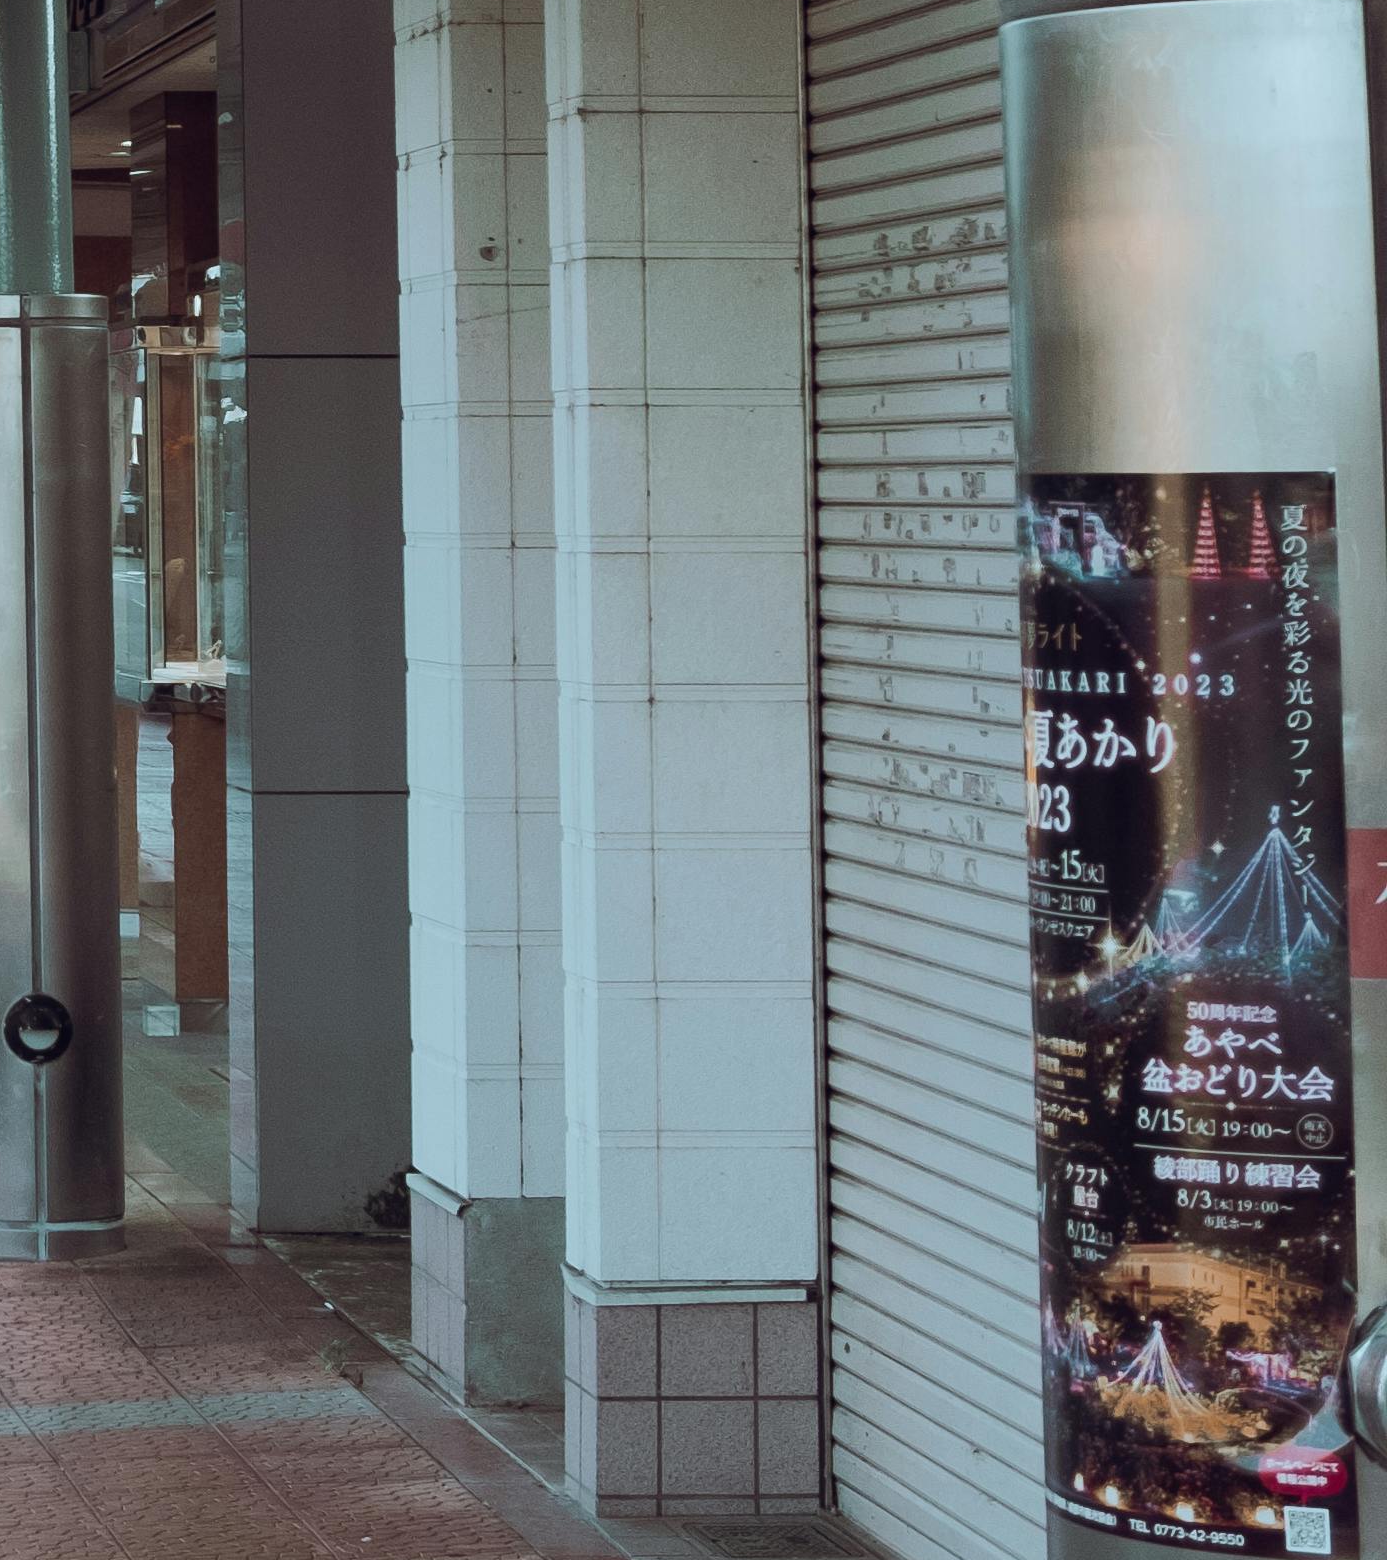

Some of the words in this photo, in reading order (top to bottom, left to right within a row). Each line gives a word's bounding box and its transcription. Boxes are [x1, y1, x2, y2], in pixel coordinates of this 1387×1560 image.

[1152, 673, 1236, 697] 2023
[1280, 503, 1317, 907] 夏の夜を彩る光のファンタジー
[1186, 1001, 1278, 1024] 50周年記念
[1183, 1025, 1283, 1059] あやべ
[1141, 1057, 1335, 1102] 盆おどり大会
[1065, 1161, 1109, 1186] クラフト
[1204, 1215, 1265, 1231] 市民ホール
[1128, 1517, 1151, 1535] TEL
[1153, 1522, 1246, 1548] 0773-42-9550
